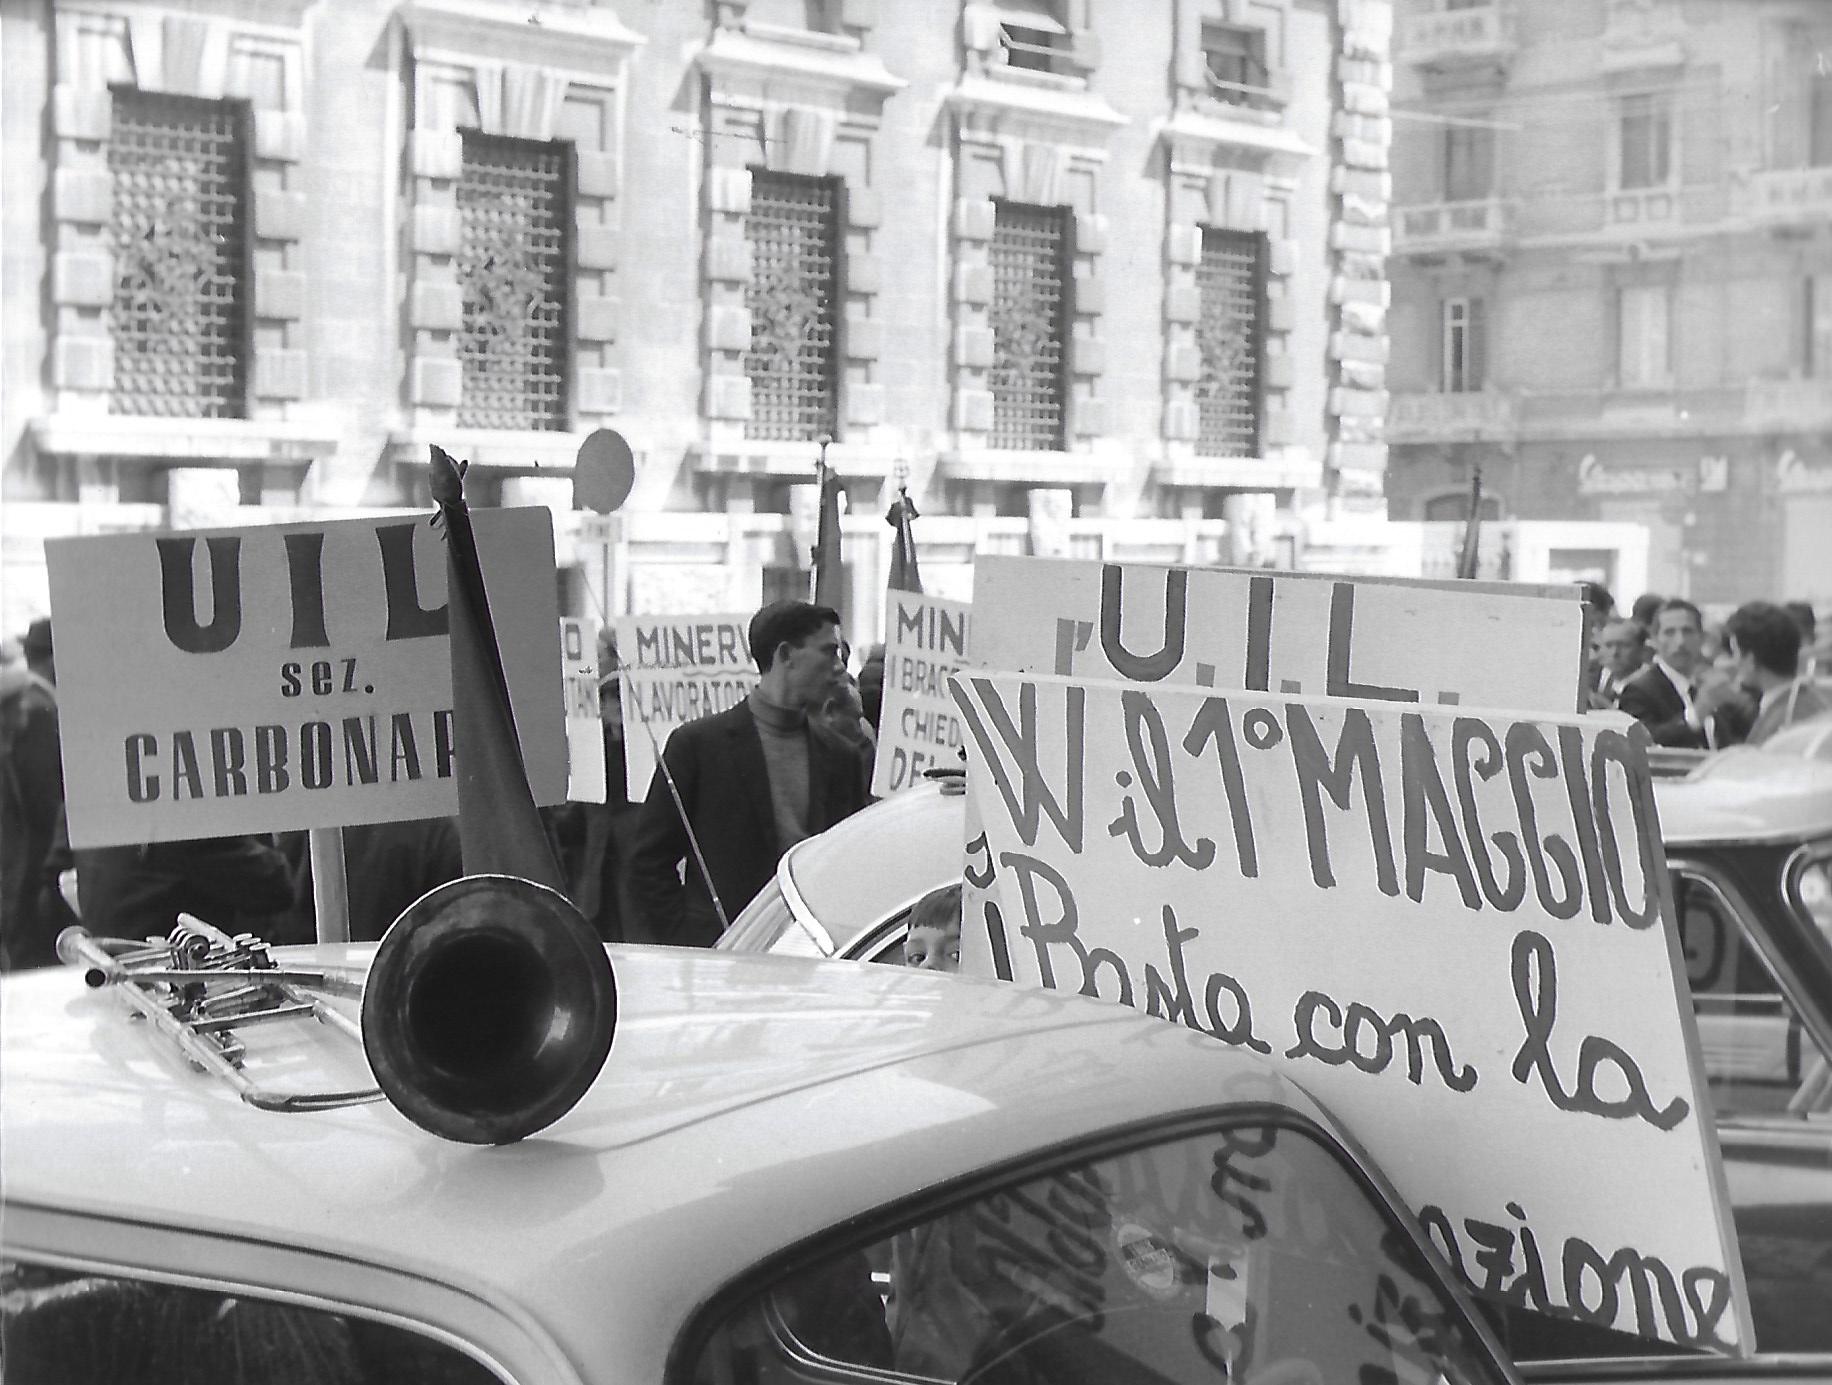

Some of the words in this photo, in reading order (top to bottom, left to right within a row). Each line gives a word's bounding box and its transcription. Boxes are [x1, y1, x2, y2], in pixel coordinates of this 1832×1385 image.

[156, 523, 450, 654] UIL
[280, 657, 376, 697] sez.
[947, 673, 1085, 855] W
[1108, 689, 1217, 871] il
[1284, 701, 1661, 930] MAGGIO
[1283, 990, 1478, 1092] con
[1511, 929, 1691, 1131] la
